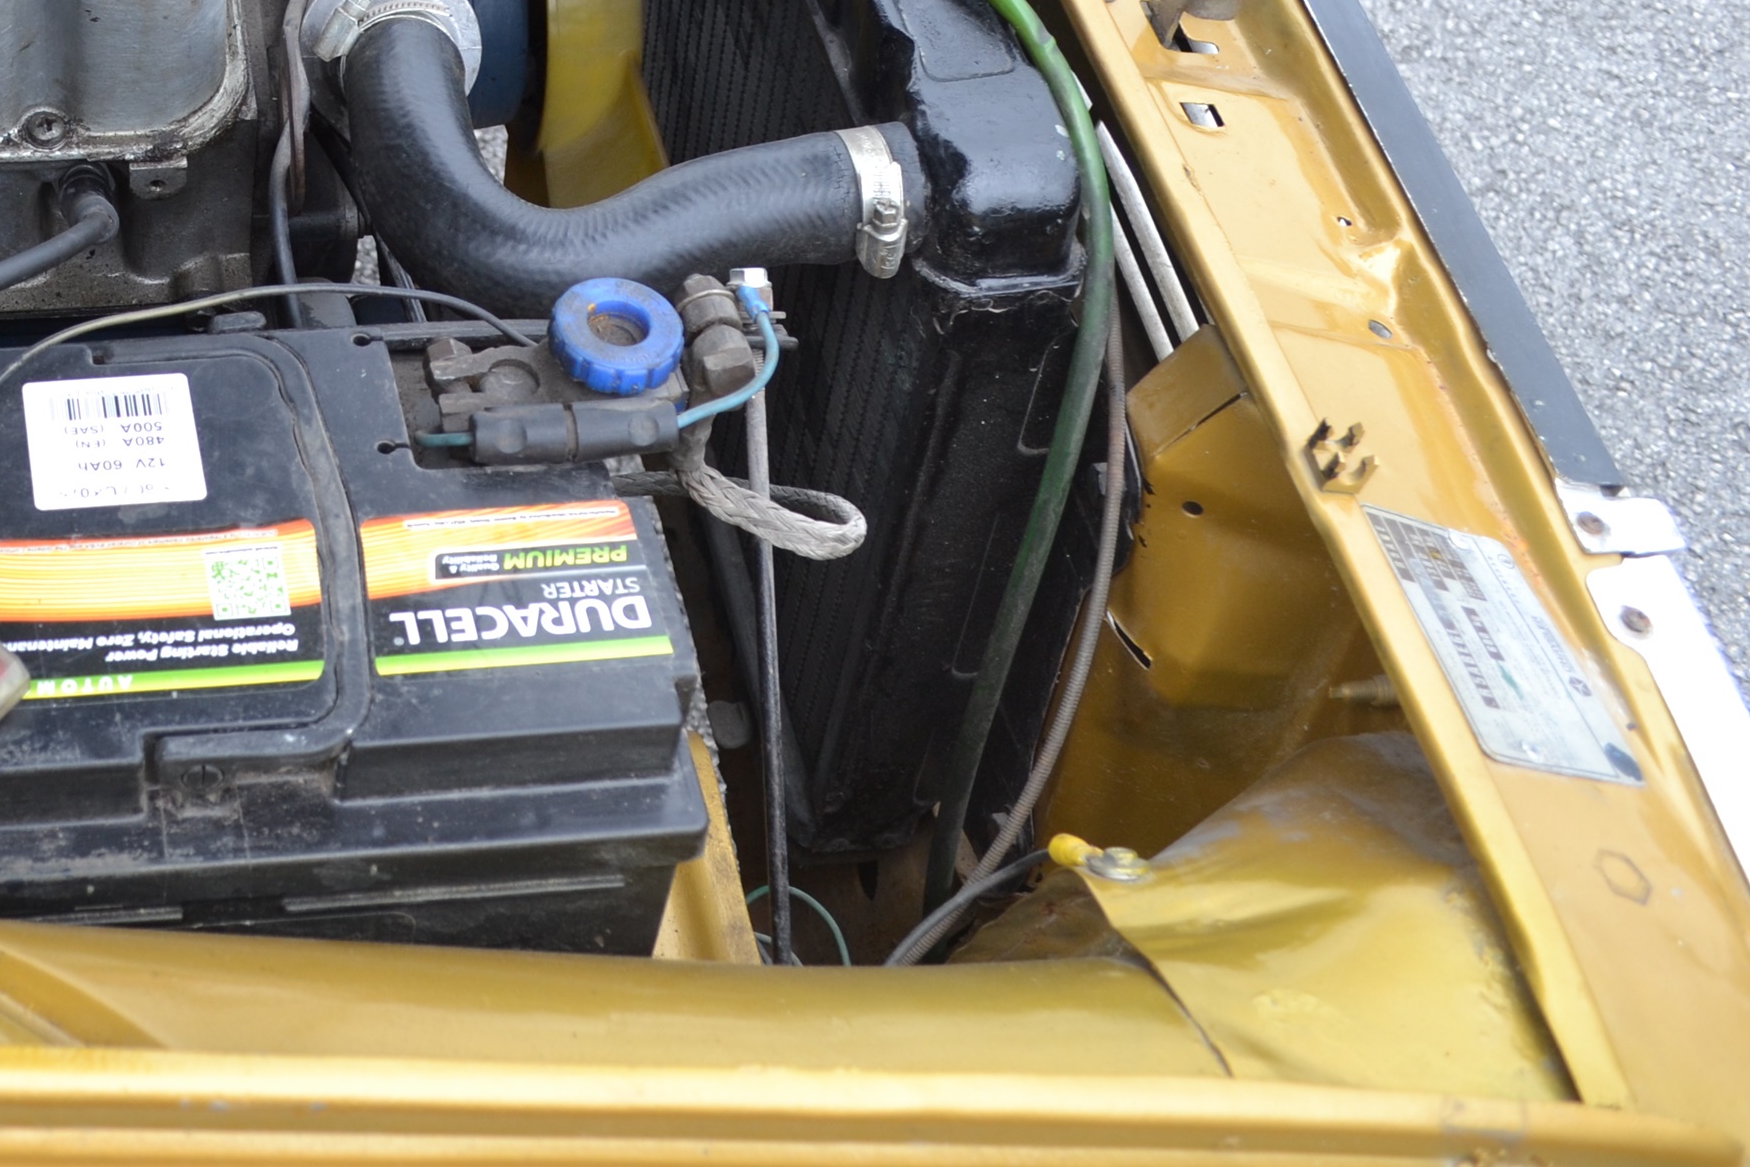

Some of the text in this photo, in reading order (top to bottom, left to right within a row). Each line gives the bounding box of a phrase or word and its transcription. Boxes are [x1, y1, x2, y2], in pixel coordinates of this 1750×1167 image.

[63, 421, 162, 435] 500A (SAE)
[75, 435, 165, 448] 480A (EN)
[77, 457, 166, 472] 12V 60Ah
[441, 553, 498, 566] Reliability
[503, 544, 628, 570] PREMIUM
[459, 561, 500, 573] Quality
[540, 576, 642, 599] STARTER
[389, 595, 653, 646] DURACELL
[137, 629, 197, 645] Safety,
[198, 621, 296, 640] Operational
[96, 633, 136, 648] Zero
[104, 638, 299, 664] Reliable Starting Power
[37, 673, 134, 695] AUTOM
